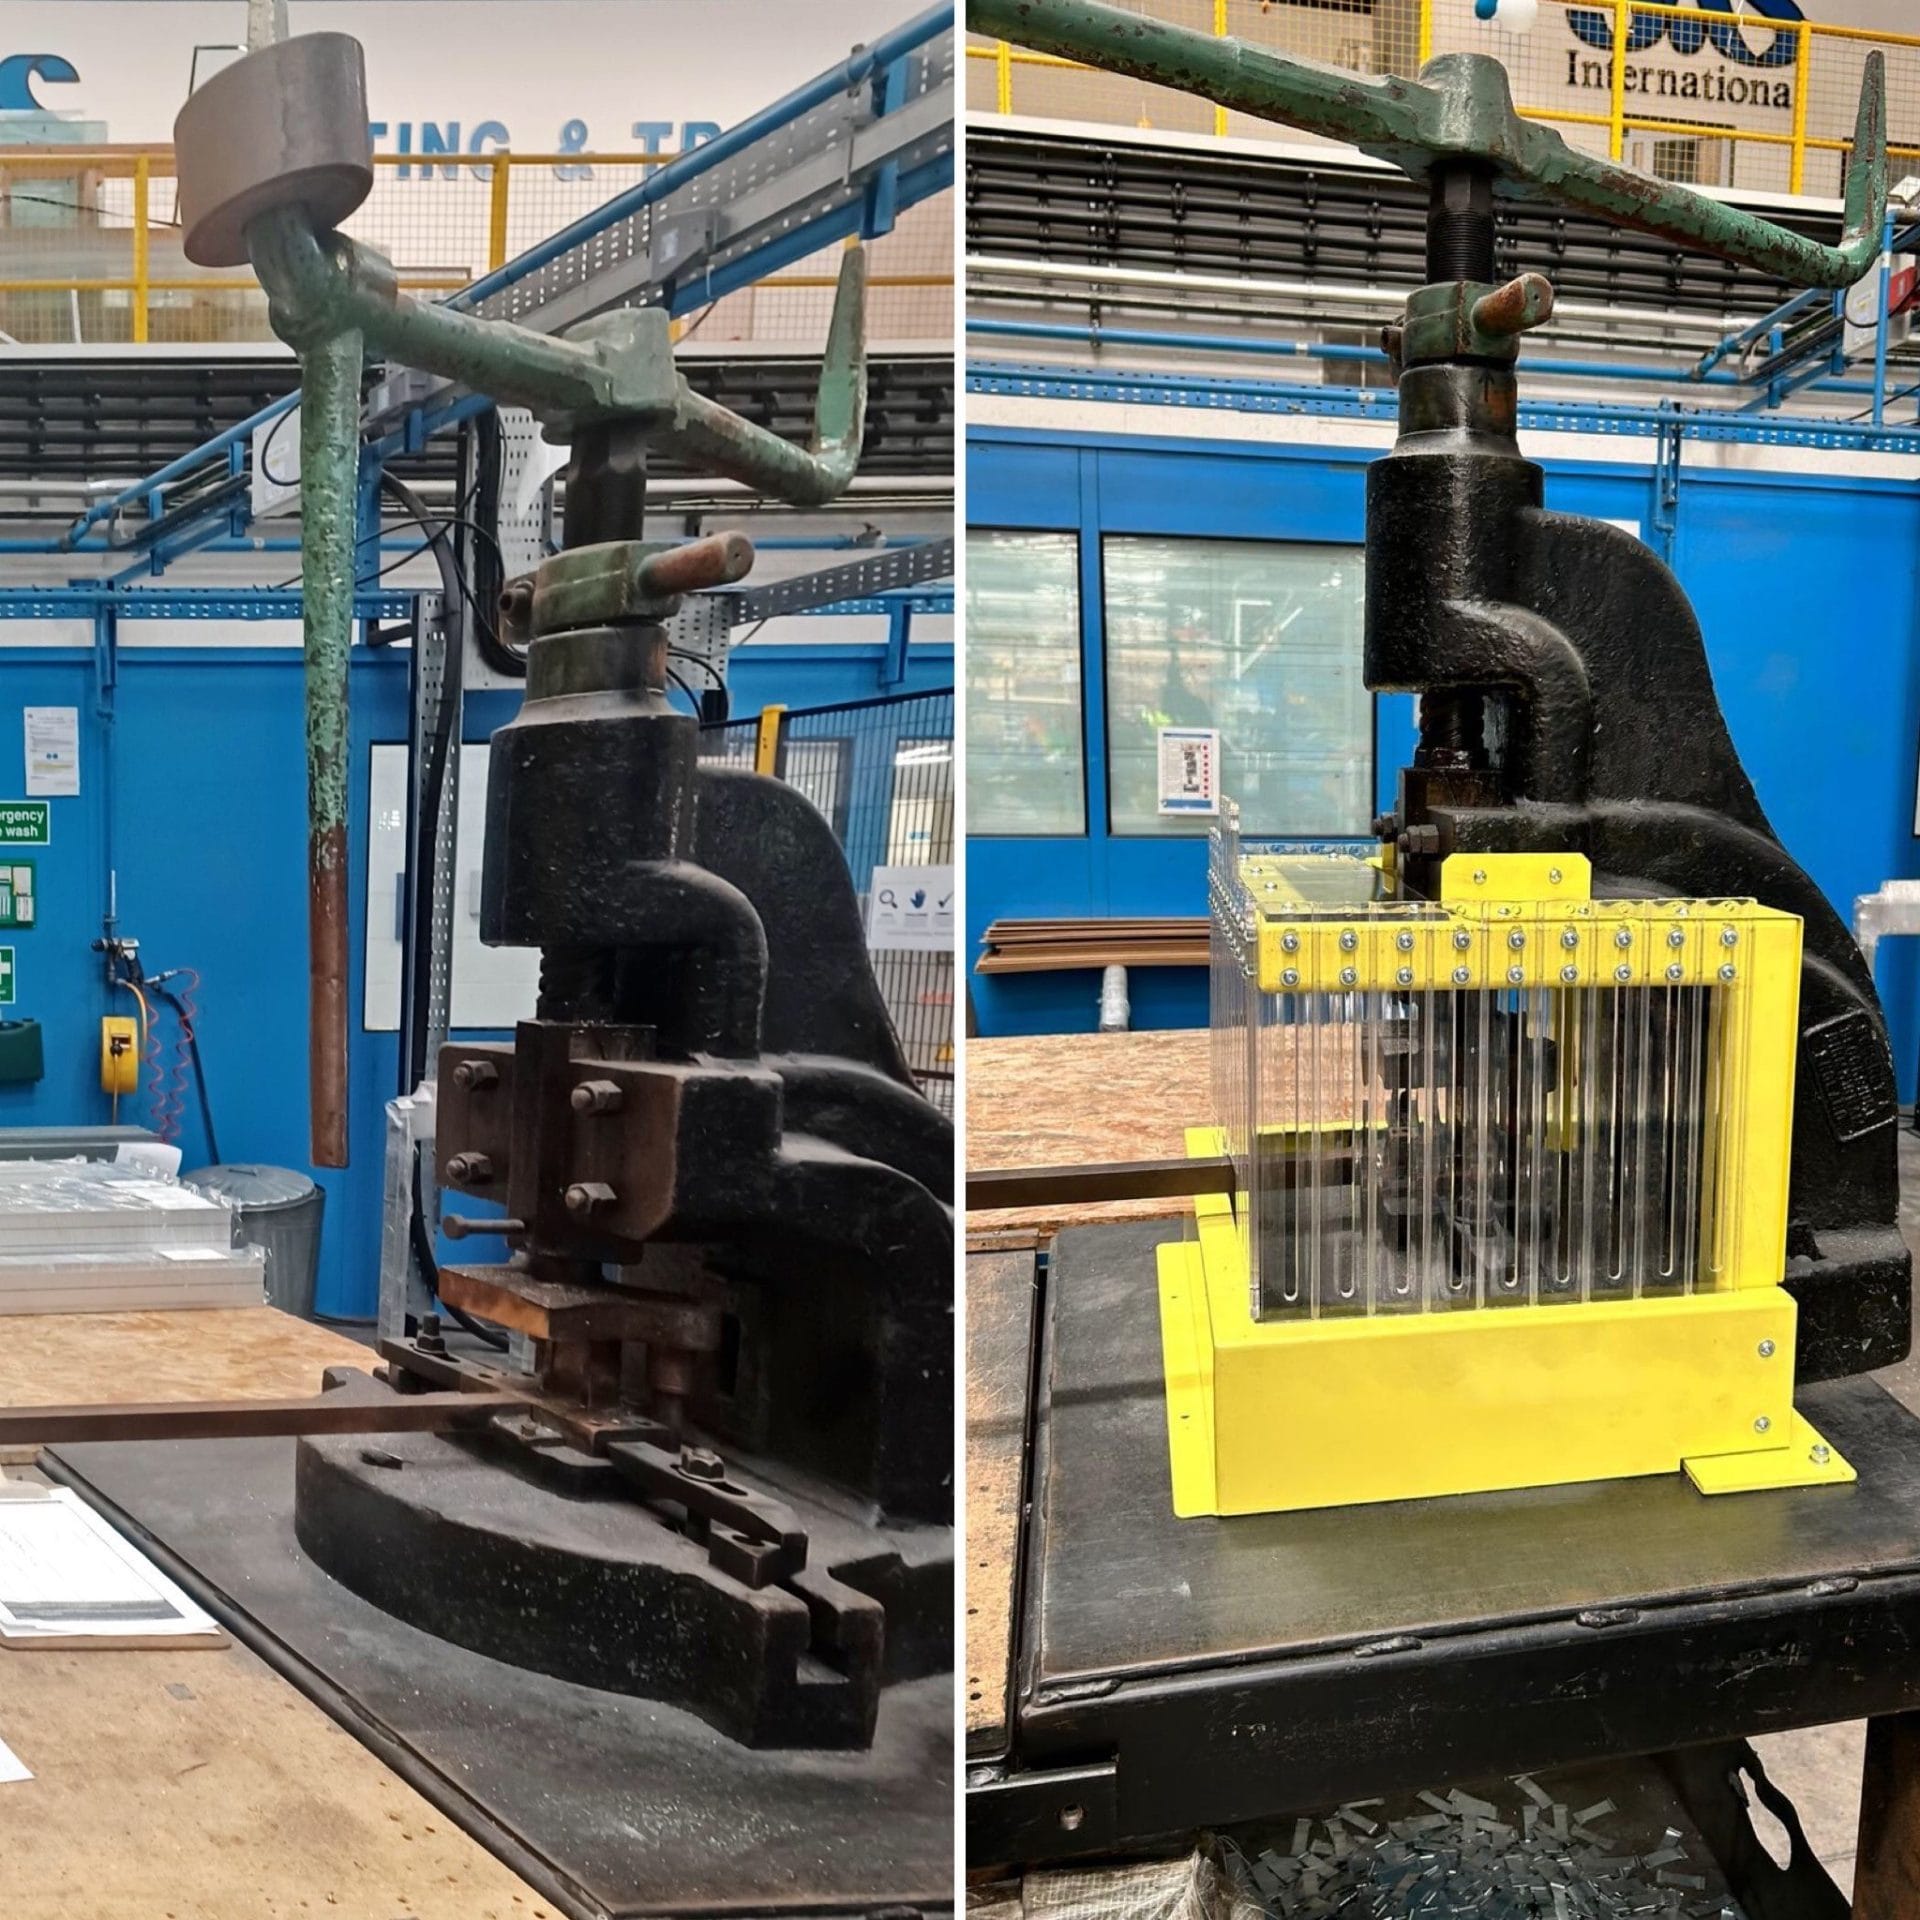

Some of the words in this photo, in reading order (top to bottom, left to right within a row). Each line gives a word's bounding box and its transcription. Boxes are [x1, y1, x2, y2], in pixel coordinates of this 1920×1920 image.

[1566, 49, 1793, 109] Internationa
[552, 118, 595, 182] &
[0, 811, 44, 824] rgency
[5, 825, 38, 837] wash
